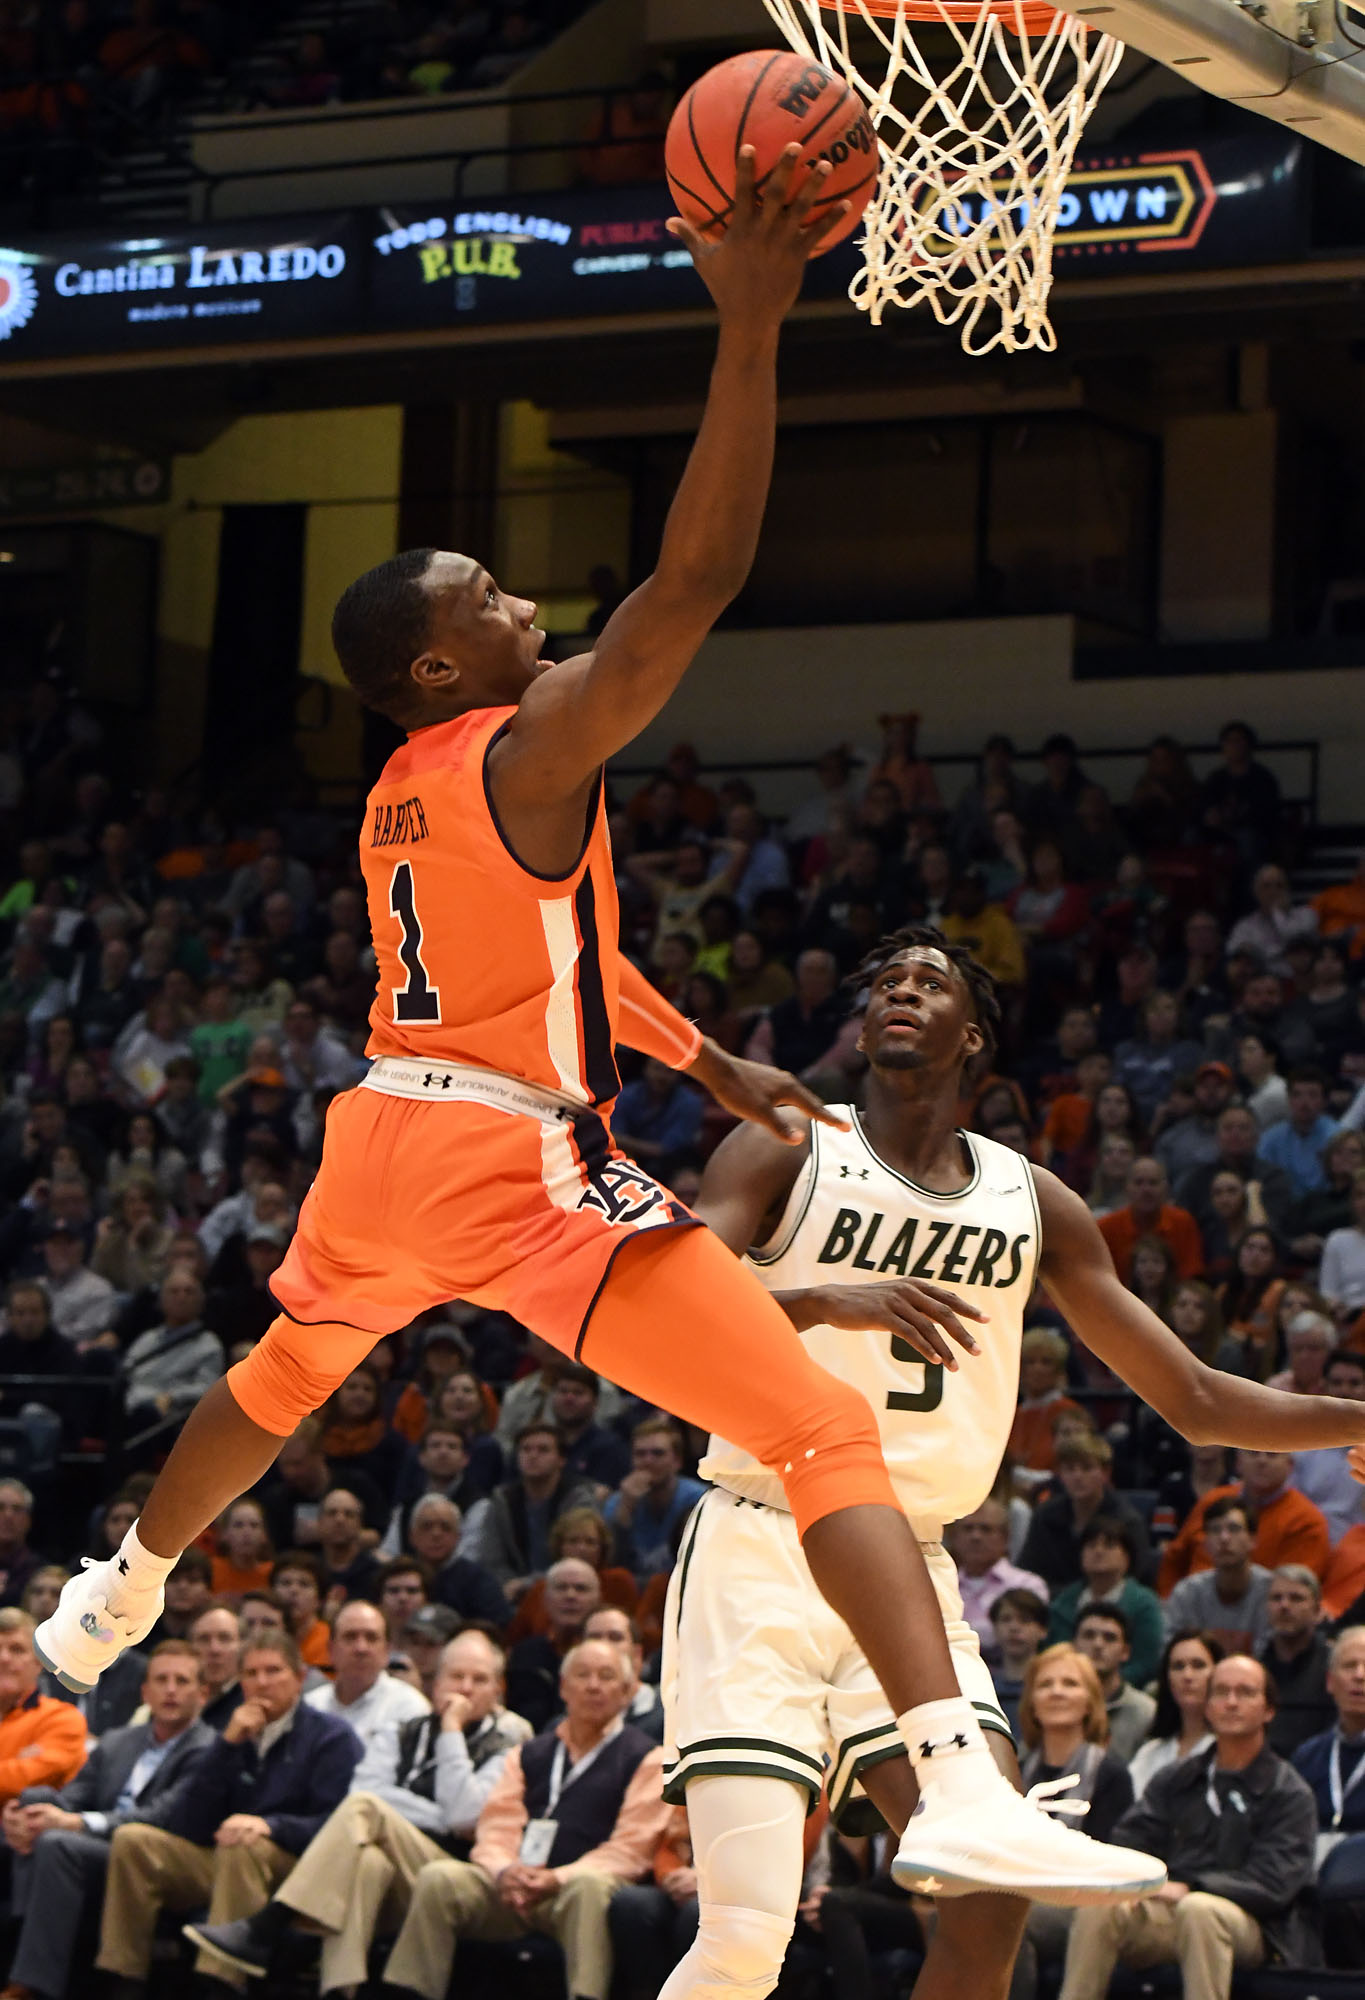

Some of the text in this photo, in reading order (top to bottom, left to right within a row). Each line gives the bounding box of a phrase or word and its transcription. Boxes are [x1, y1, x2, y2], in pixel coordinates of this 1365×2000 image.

[453, 212, 572, 245] ENGLISH
[55, 245, 346, 297] Cantina LAREDO
[371, 796, 429, 848] HARPER
[389, 859, 442, 1025] 1
[817, 1208, 1030, 1288] BLAZERS
